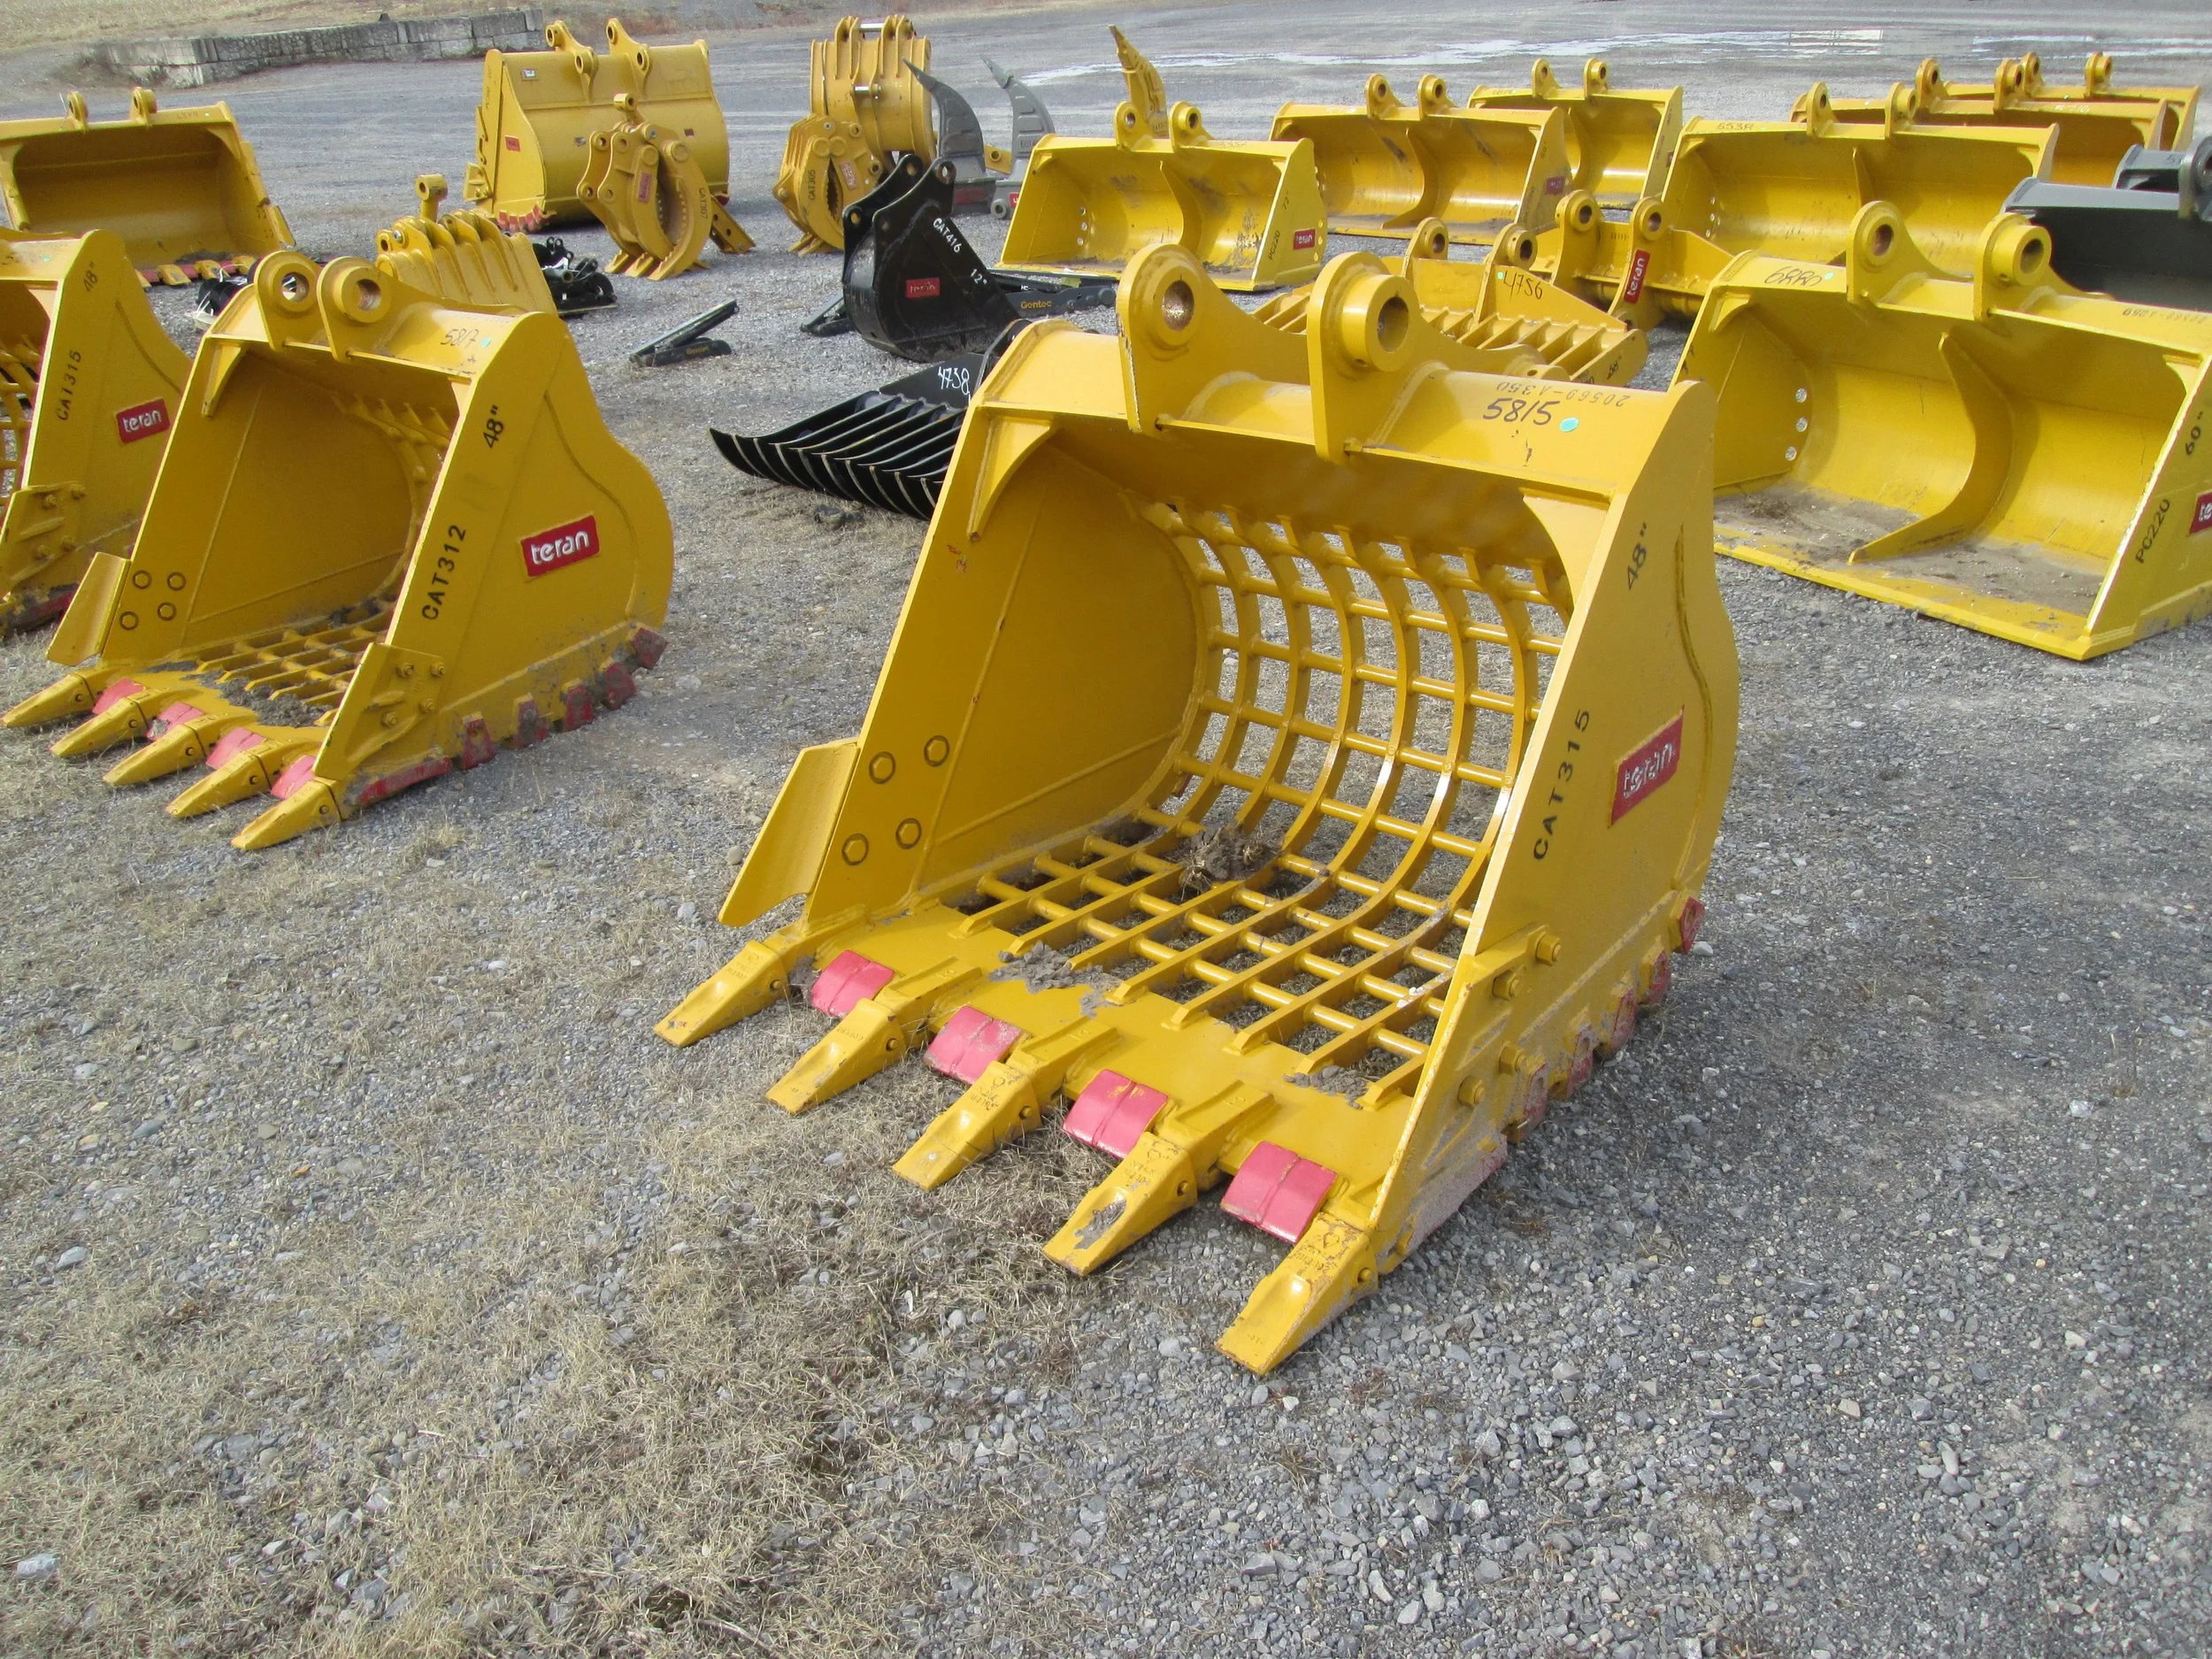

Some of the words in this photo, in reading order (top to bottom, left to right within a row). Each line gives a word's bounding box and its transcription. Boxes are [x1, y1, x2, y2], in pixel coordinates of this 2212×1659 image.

[933, 217, 963, 253] CAT416
[1626, 257, 1646, 296] teran
[57, 349, 82, 422] CAT315
[122, 408, 163, 434] teran
[482, 404, 505, 449] 48"
[1482, 397, 1561, 426] 5815
[530, 530, 590, 565] teran
[1626, 521, 1647, 591] 48"
[2134, 497, 2171, 565] PC220
[421, 524, 467, 621] CAT312
[1532, 708, 1591, 861] CAT315
[1623, 742, 1676, 800] teran
